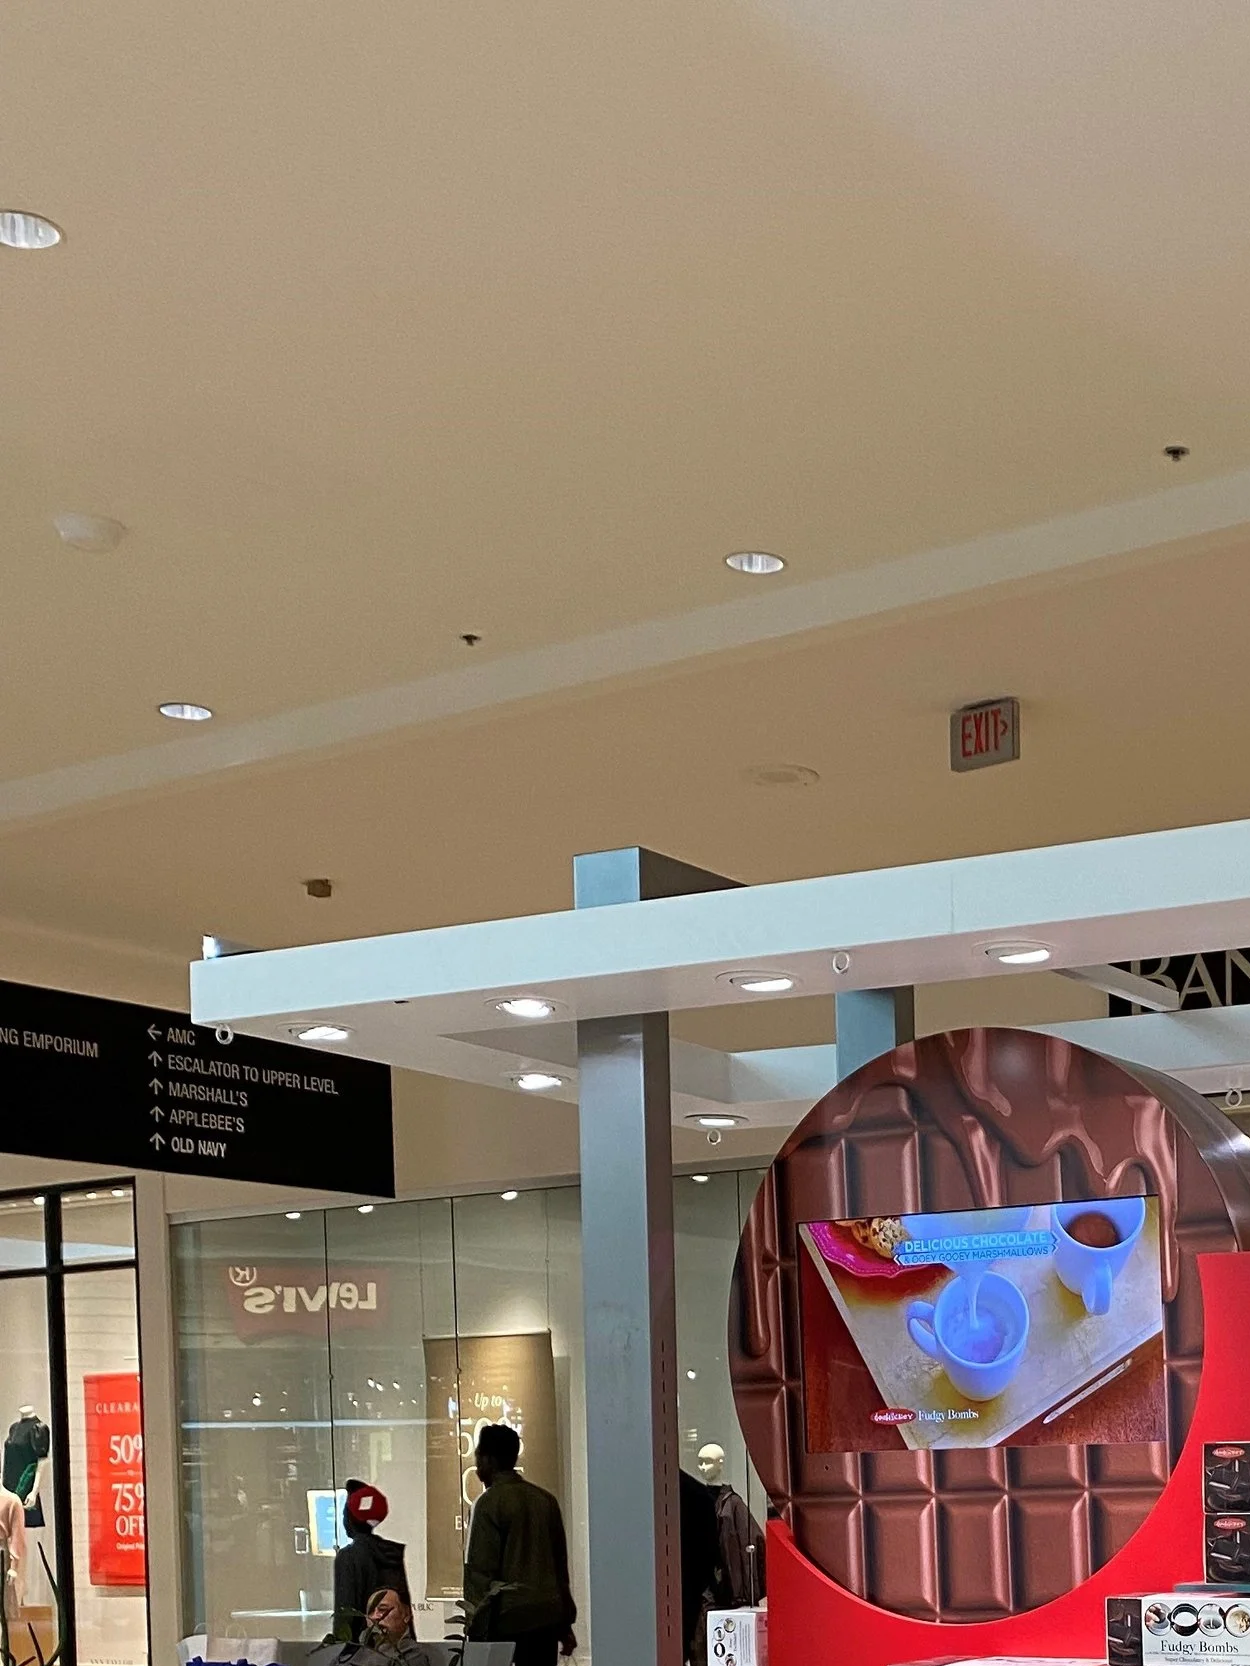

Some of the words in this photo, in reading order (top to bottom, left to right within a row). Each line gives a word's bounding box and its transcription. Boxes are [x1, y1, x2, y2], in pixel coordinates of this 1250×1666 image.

[962, 708, 1001, 758] EXIT
[23, 1031, 98, 1058] EMPORIUM
[167, 1028, 195, 1045] AMC
[168, 1055, 240, 1080] ESCALATOR
[243, 1066, 258, 1082] TO
[262, 1069, 301, 1089] UPPER
[304, 1075, 338, 1095] LEVEL
[169, 1082, 248, 1107] MARSHALL'S
[169, 1109, 244, 1132] APPLEBEE'S
[171, 1137, 194, 1153] OLD
[198, 1141, 226, 1158] NAVY
[905, 1239, 968, 1252] DELICIOUS
[972, 1232, 1047, 1248] CHOCOLATE
[912, 1255, 936, 1263] OOEY
[939, 1253, 970, 1261] GOOEY
[972, 1247, 1049, 1259] MARSHMALLOWS
[474, 1392, 488, 1411] Up
[489, 1395, 501, 1407] to
[918, 1410, 944, 1423] Fudgy
[948, 1409, 979, 1420] Bombs
[1161, 1640, 1196, 1655] Fudgy
[1199, 1642, 1239, 1653] Bombs
